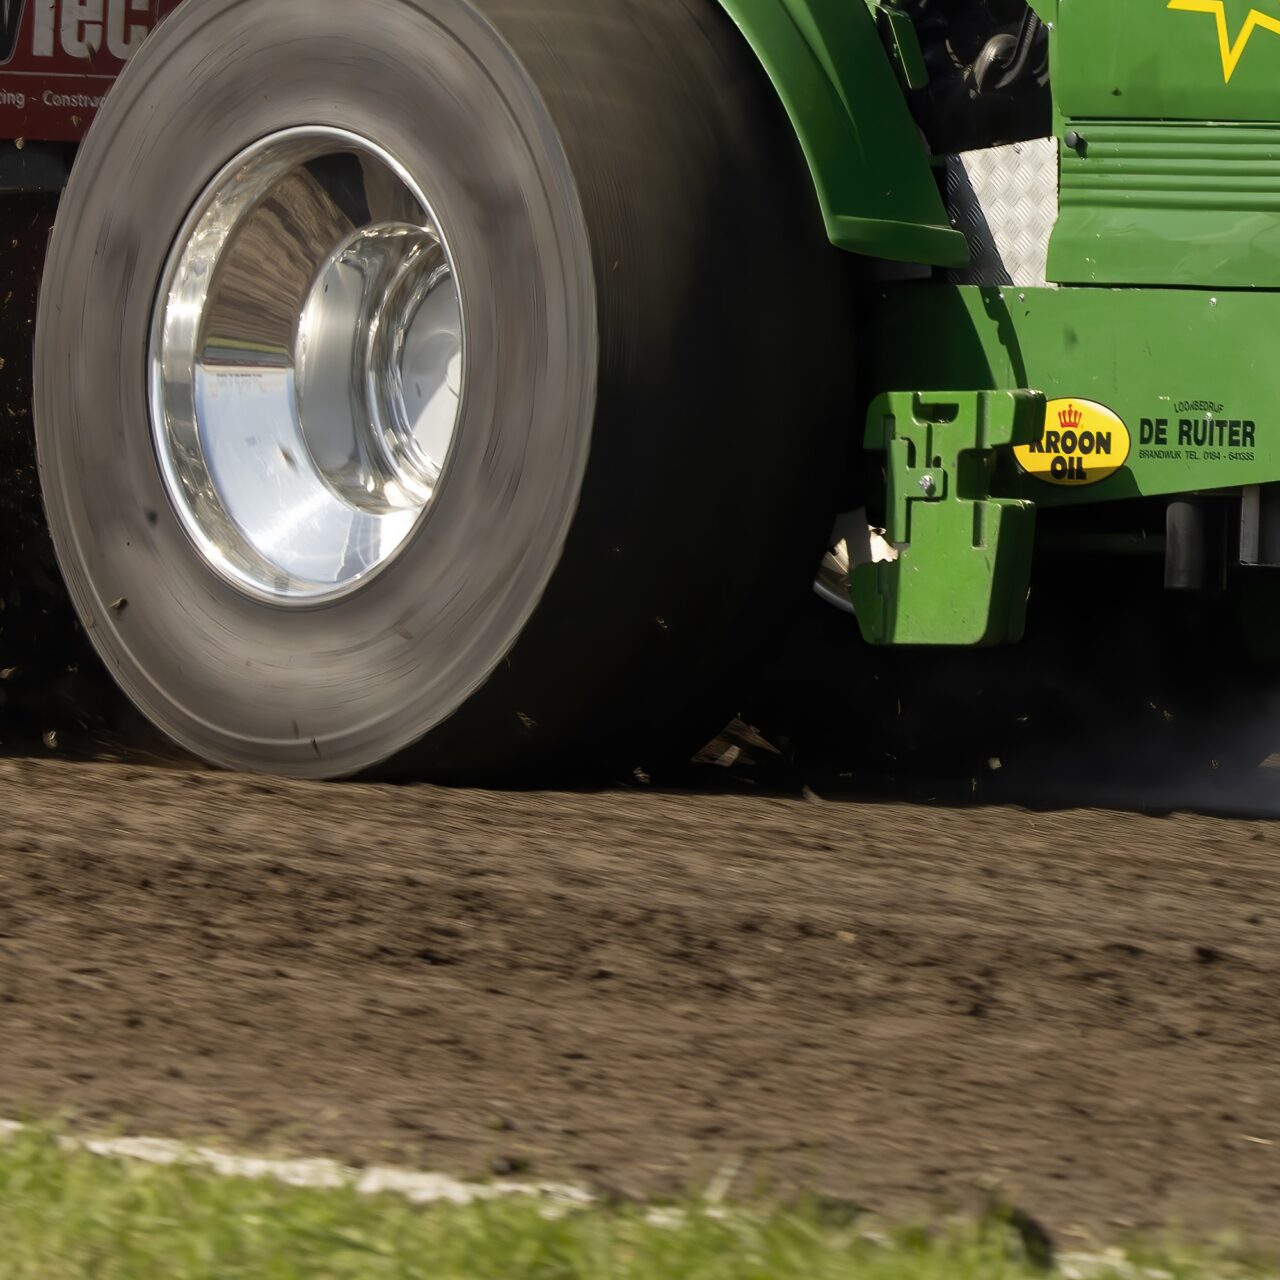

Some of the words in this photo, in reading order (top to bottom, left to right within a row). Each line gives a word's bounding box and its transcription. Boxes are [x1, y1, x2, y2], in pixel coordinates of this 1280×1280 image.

[1139, 417, 1168, 446] DE
[1178, 418, 1256, 448] RUITER
[1050, 455, 1087, 480] OIL
